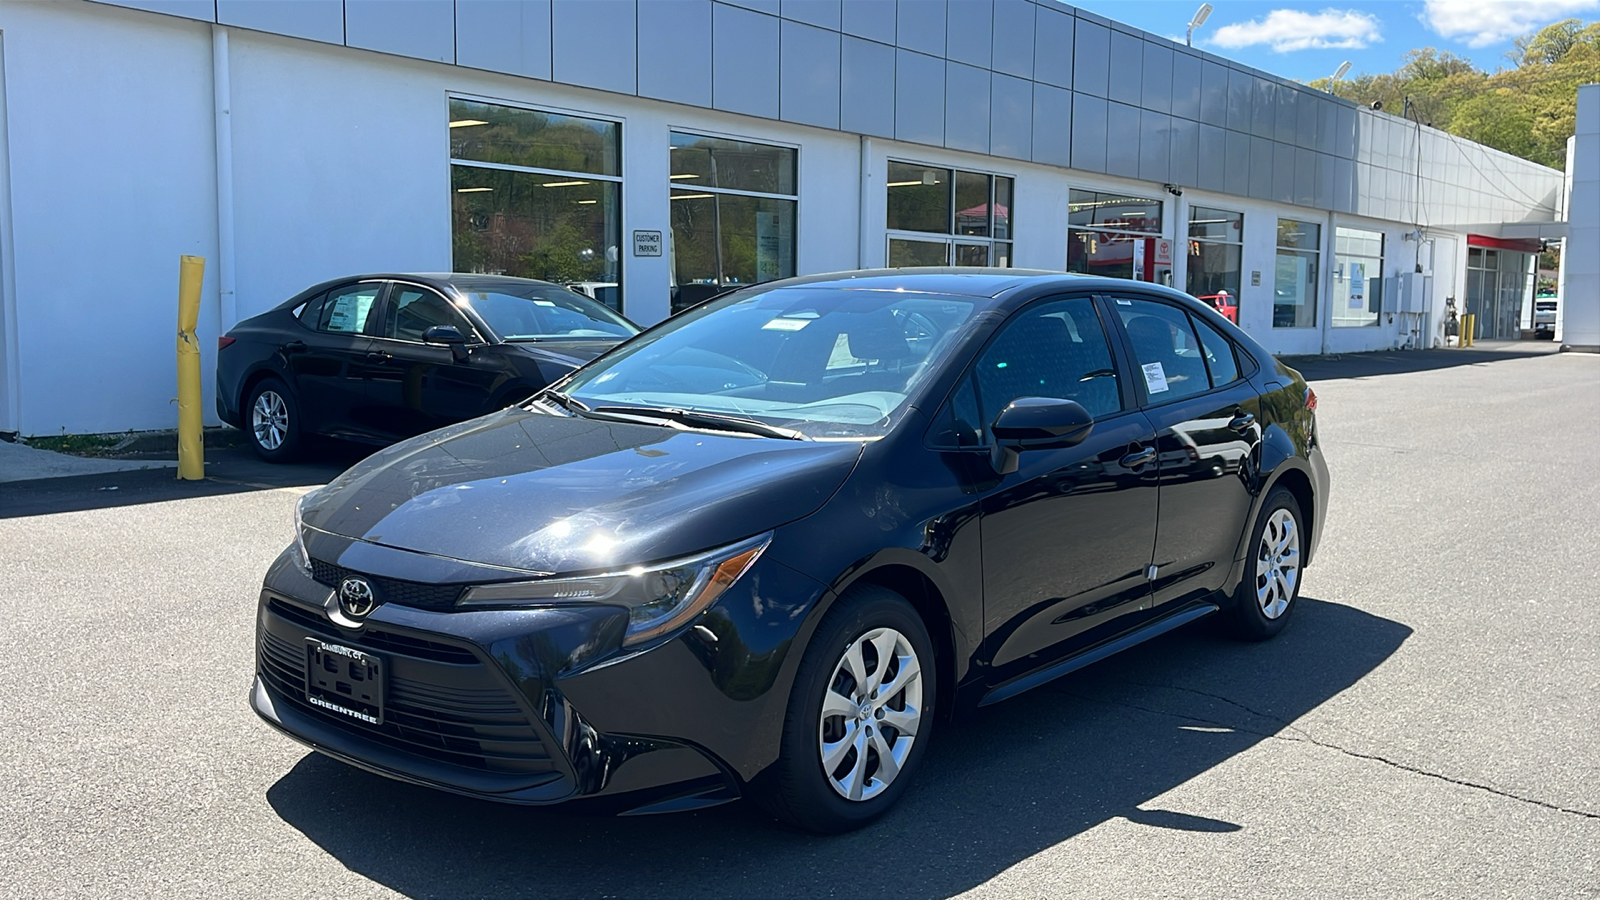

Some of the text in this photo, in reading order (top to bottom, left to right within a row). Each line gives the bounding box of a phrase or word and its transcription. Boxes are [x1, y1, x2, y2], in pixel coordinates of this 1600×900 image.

[636, 234, 659, 242] CUSTOMER
[639, 244, 657, 252] PARKING
[309, 697, 377, 724] GREENTREE
